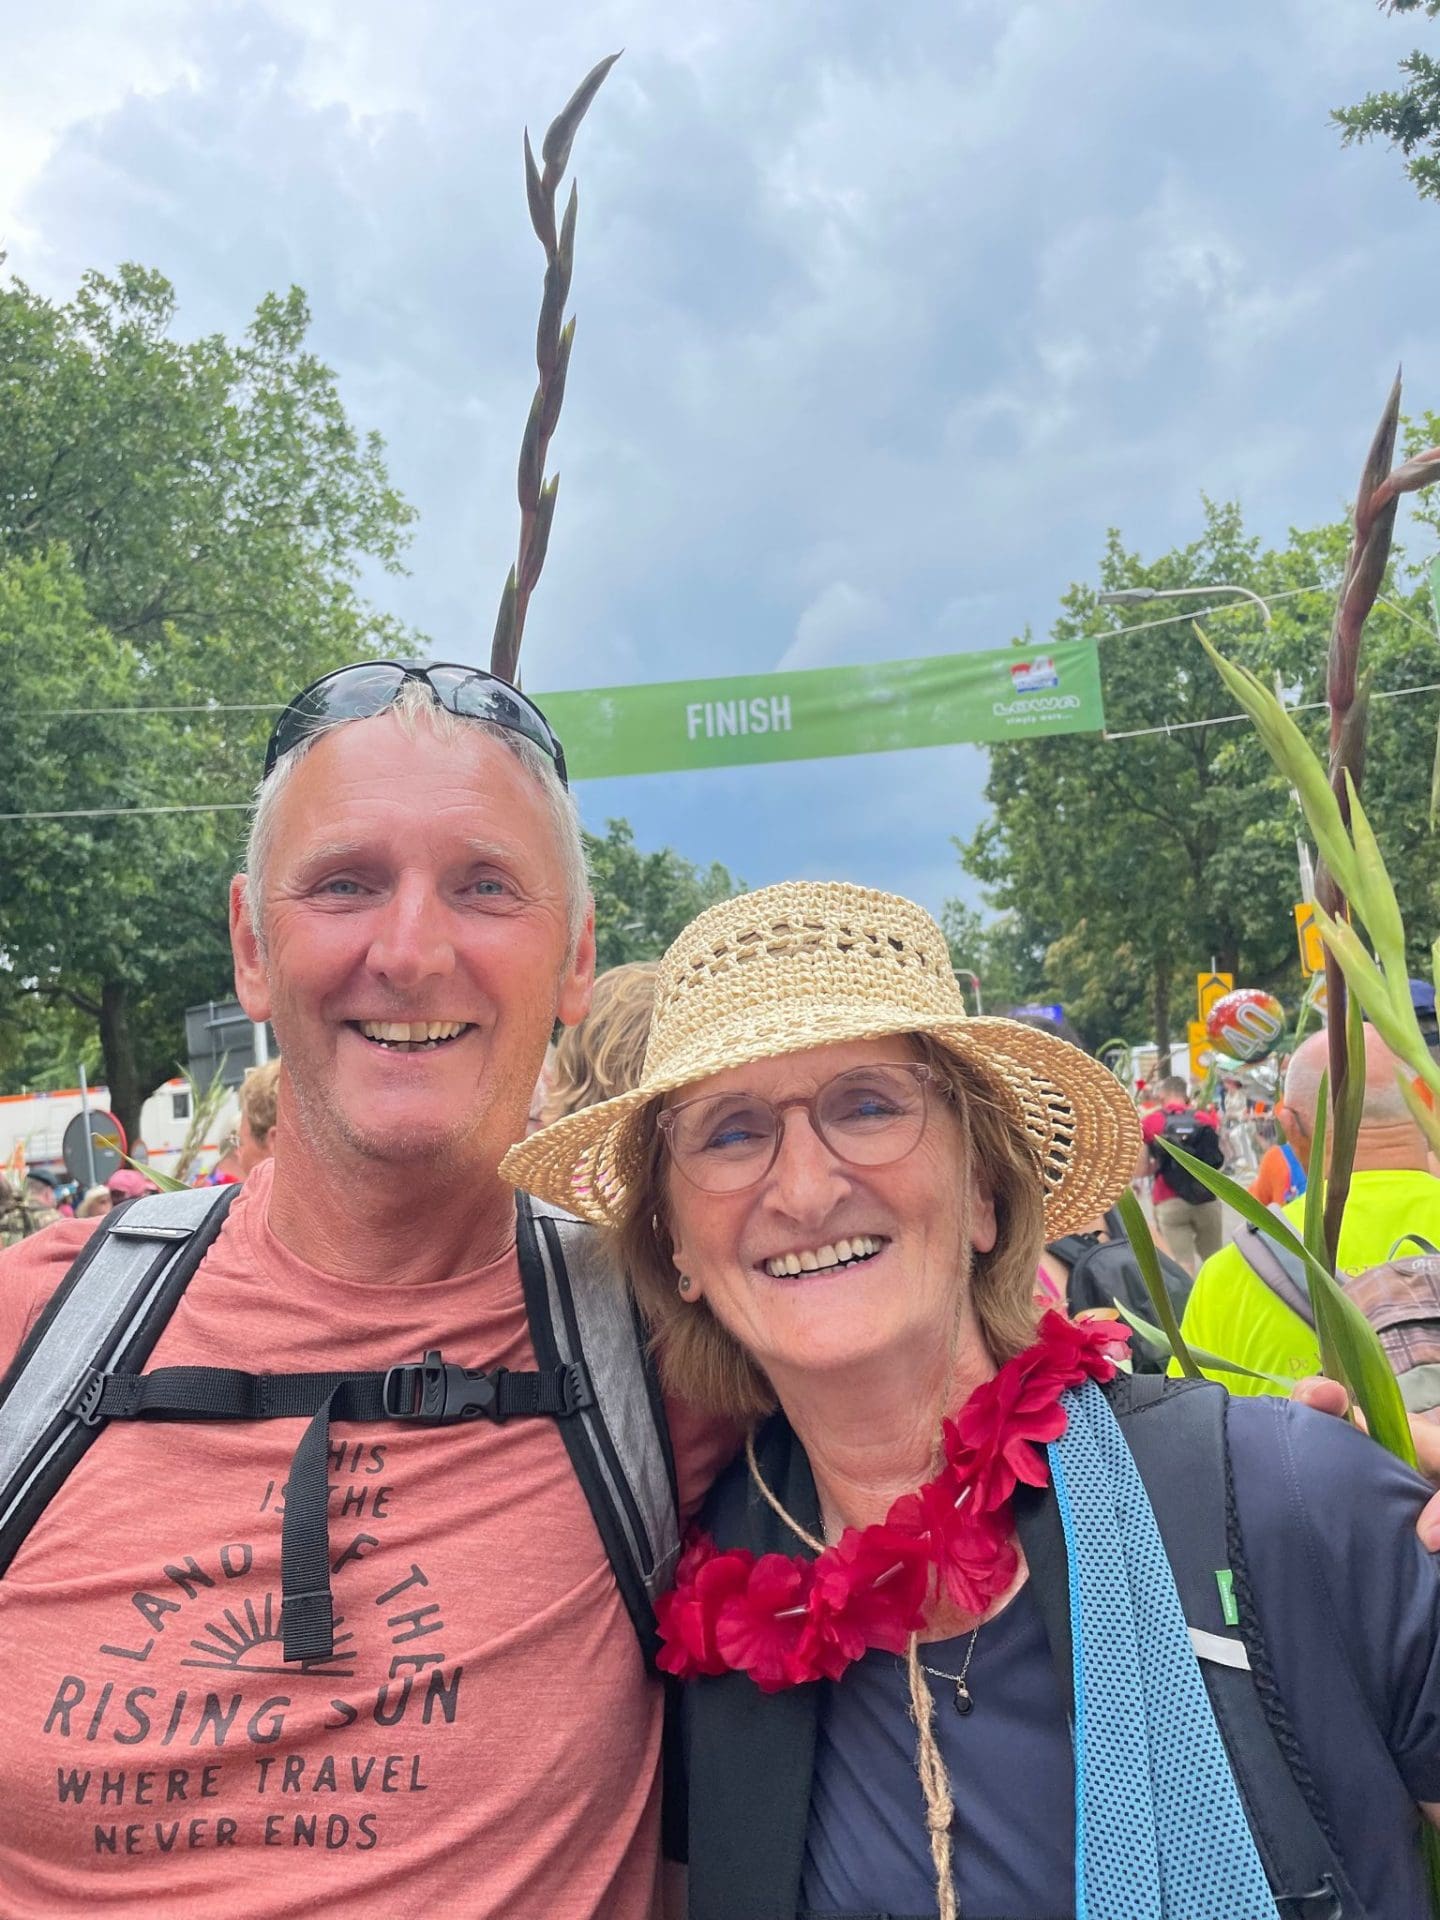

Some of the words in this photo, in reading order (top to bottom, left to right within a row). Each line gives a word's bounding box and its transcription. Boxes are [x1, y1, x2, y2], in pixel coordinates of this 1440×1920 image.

[686, 695, 792, 740] FINISH
[327, 1440, 387, 1474] HIS
[99, 1543, 253, 1662] LAND
[331, 1533, 379, 1574] F
[375, 1563, 445, 1679] THE
[43, 1675, 291, 1746] RISING
[57, 1765, 222, 1805] WHERE
[256, 1754, 428, 1794] TRAVEL
[95, 1817, 238, 1855] NEVER
[264, 1813, 377, 1850] ENDS
